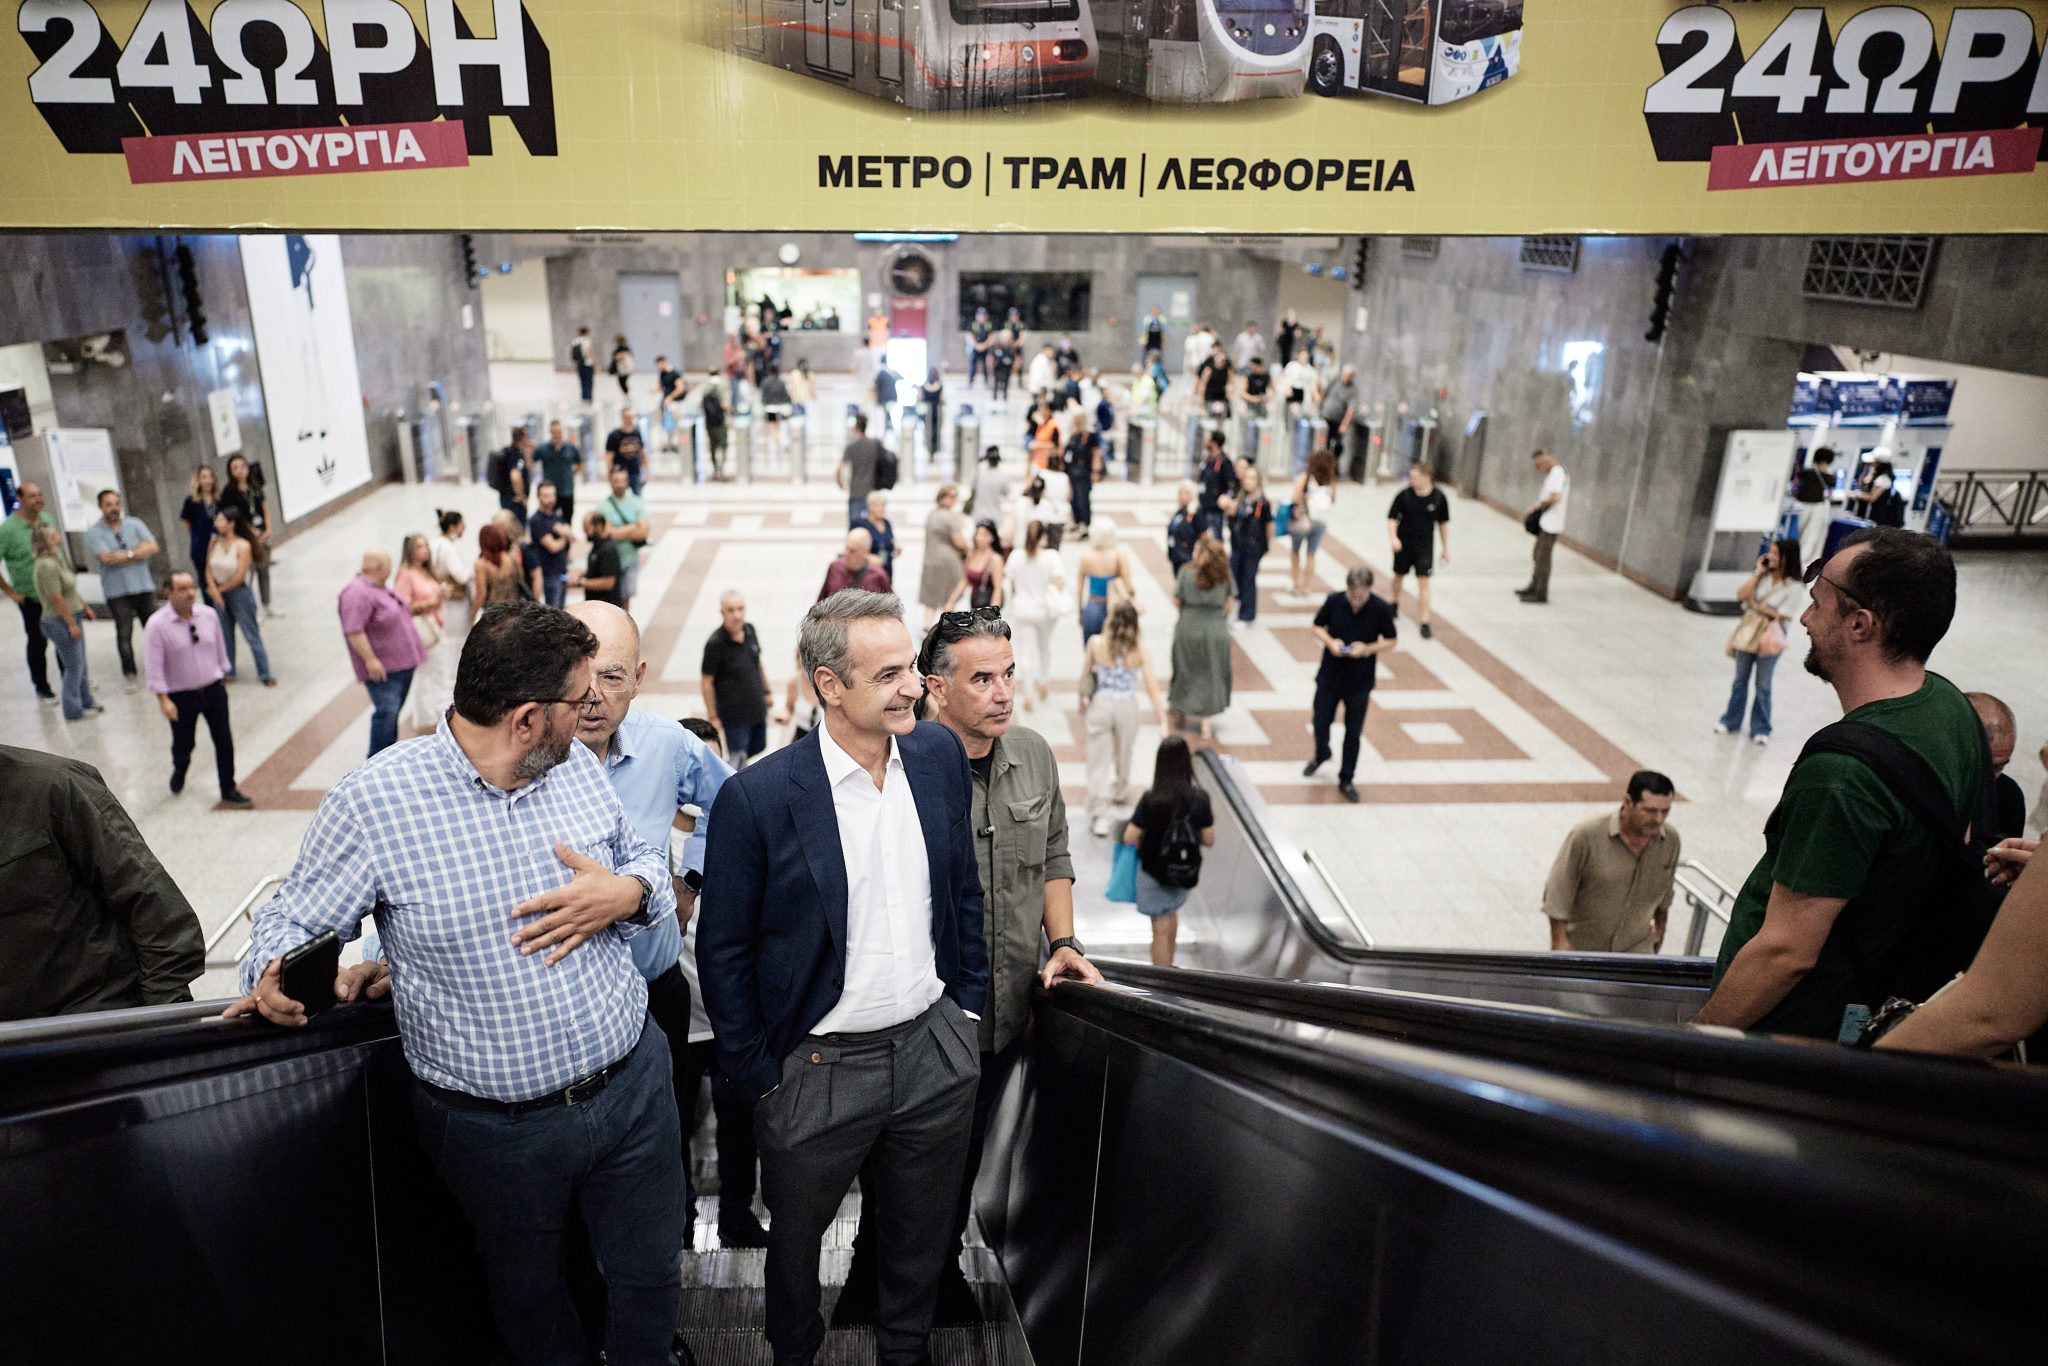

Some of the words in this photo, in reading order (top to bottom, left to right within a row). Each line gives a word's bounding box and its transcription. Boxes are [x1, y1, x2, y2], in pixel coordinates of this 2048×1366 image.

[18, 0, 530, 106] 24ΩΡΗ
[1643, 5, 2048, 114] 24ΩΡ
[172, 128, 426, 175] ΛΕΙΤΟΥΡΓΙΑ
[818, 155, 972, 189] ΜΕΤΡΟ
[1003, 156, 1127, 190] ΤΡΑΜ
[1157, 157, 1415, 192] ΛΕΩΦΟΡΕΙΑ
[1749, 136, 1995, 182] ΛΕΙΤΟΥΡΓΙΑ
